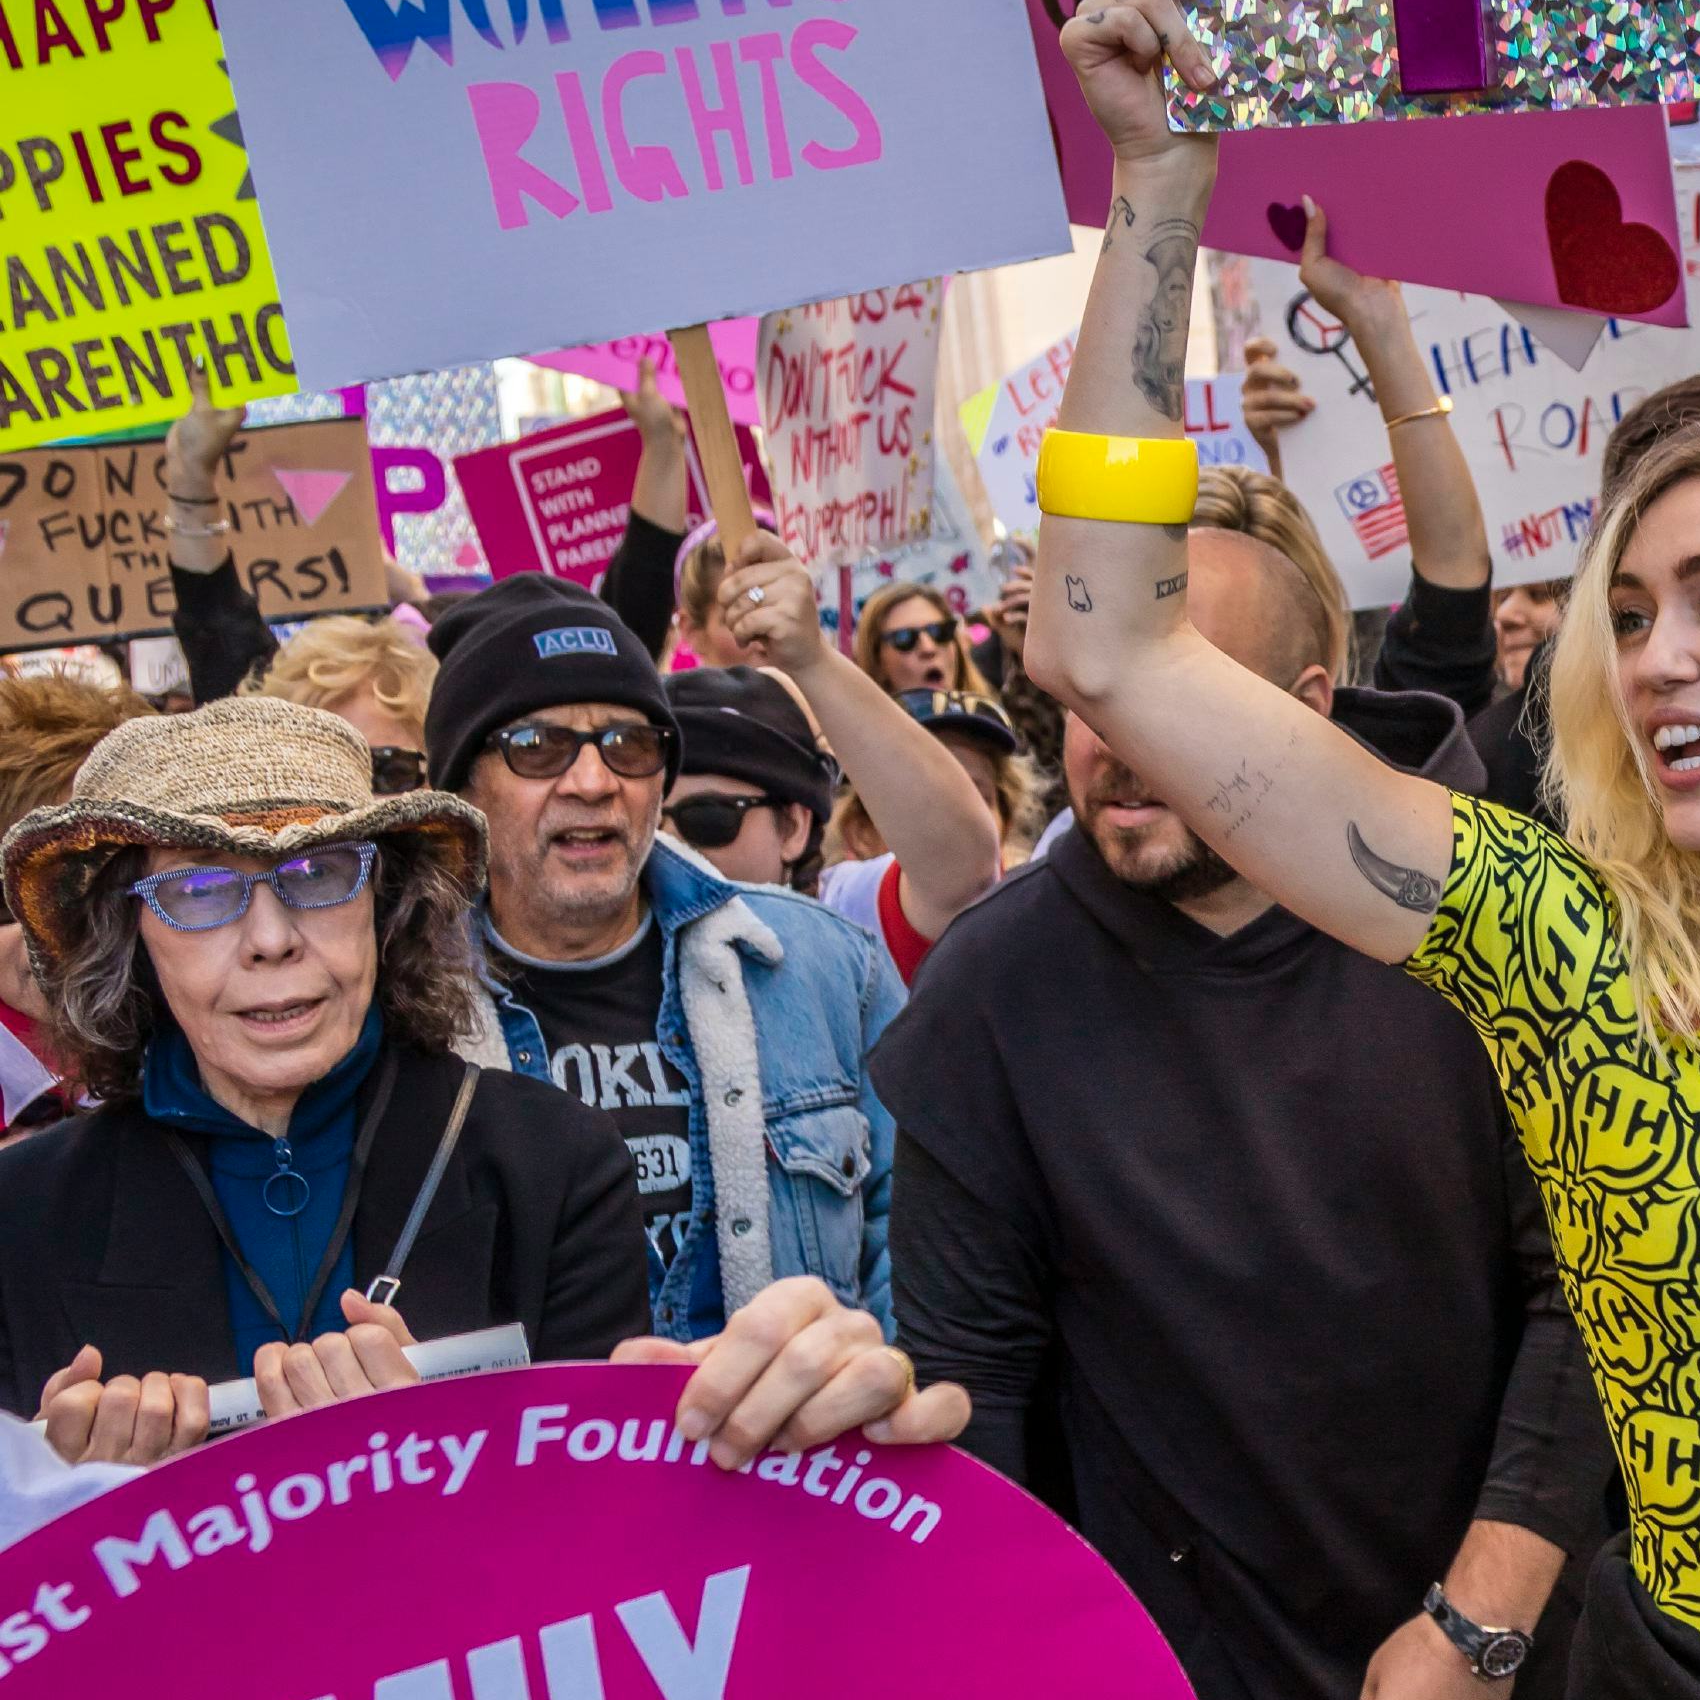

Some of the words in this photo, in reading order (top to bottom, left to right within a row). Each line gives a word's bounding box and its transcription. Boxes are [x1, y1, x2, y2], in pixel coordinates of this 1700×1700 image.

[467, 18, 884, 231] RIGHTS
[0, 212, 251, 333] ANNED
[104, 442, 248, 497] NT
[530, 456, 603, 494] STAND
[38, 509, 167, 552] FUCK
[228, 497, 298, 534] ITH
[538, 487, 595, 518] WITH
[111, 552, 161, 572] TH
[15, 547, 350, 633] QUERS!
[538, 629, 613, 654] ACLU
[93, 1431, 488, 1598] Majority
[515, 1403, 945, 1547] Founation
